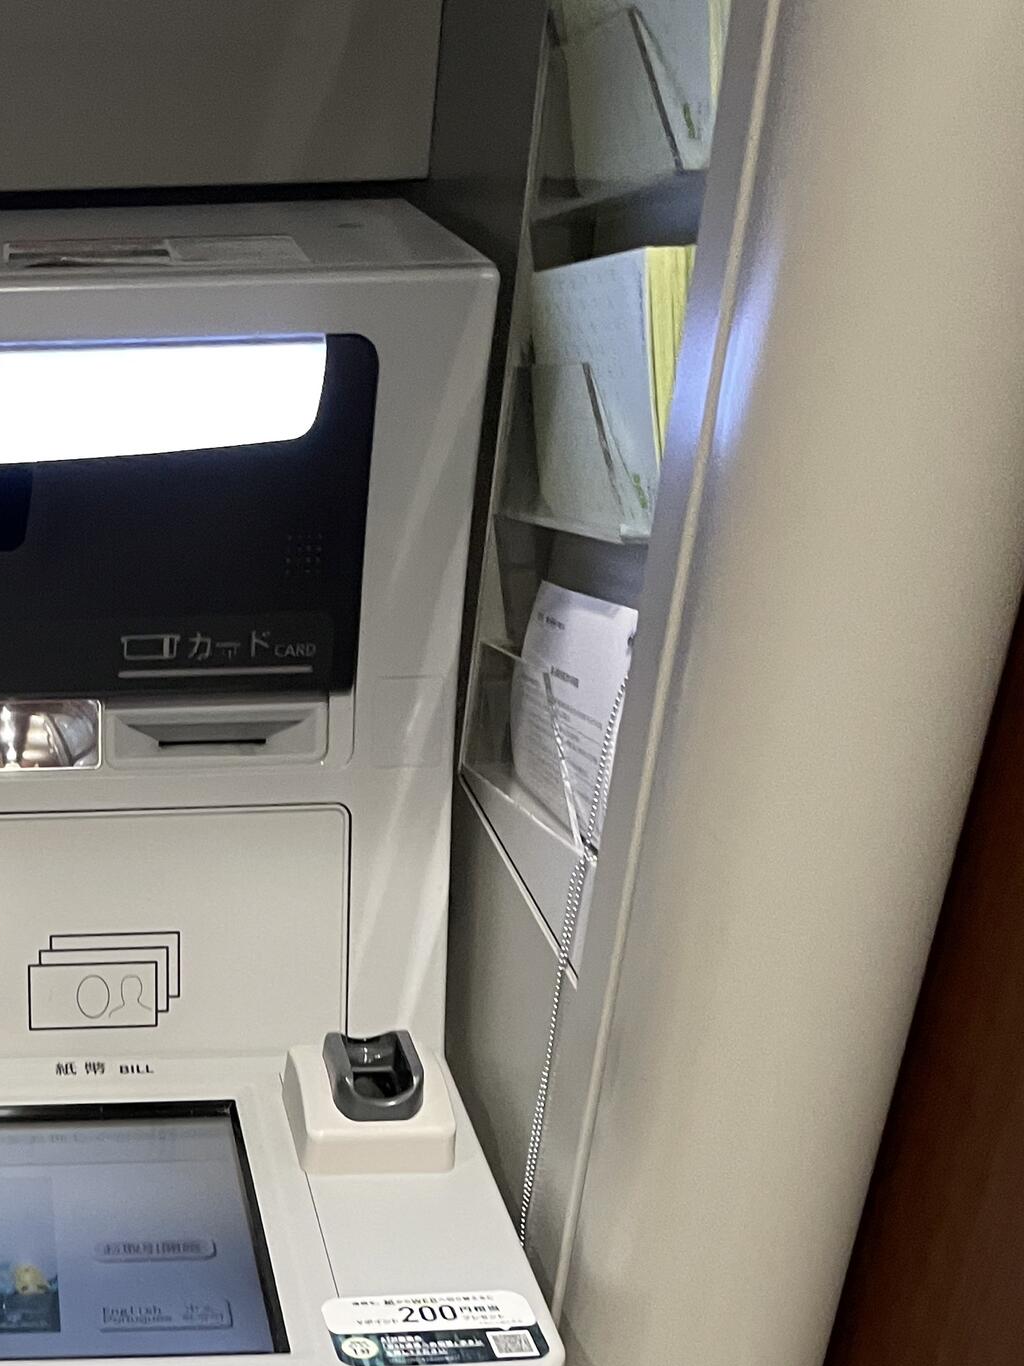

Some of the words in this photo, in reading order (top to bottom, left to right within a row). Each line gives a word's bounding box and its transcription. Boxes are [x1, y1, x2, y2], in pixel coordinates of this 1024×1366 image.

[188, 630, 271, 660] カード
[274, 642, 317, 657] CARD
[119, 1063, 155, 1075] BILL
